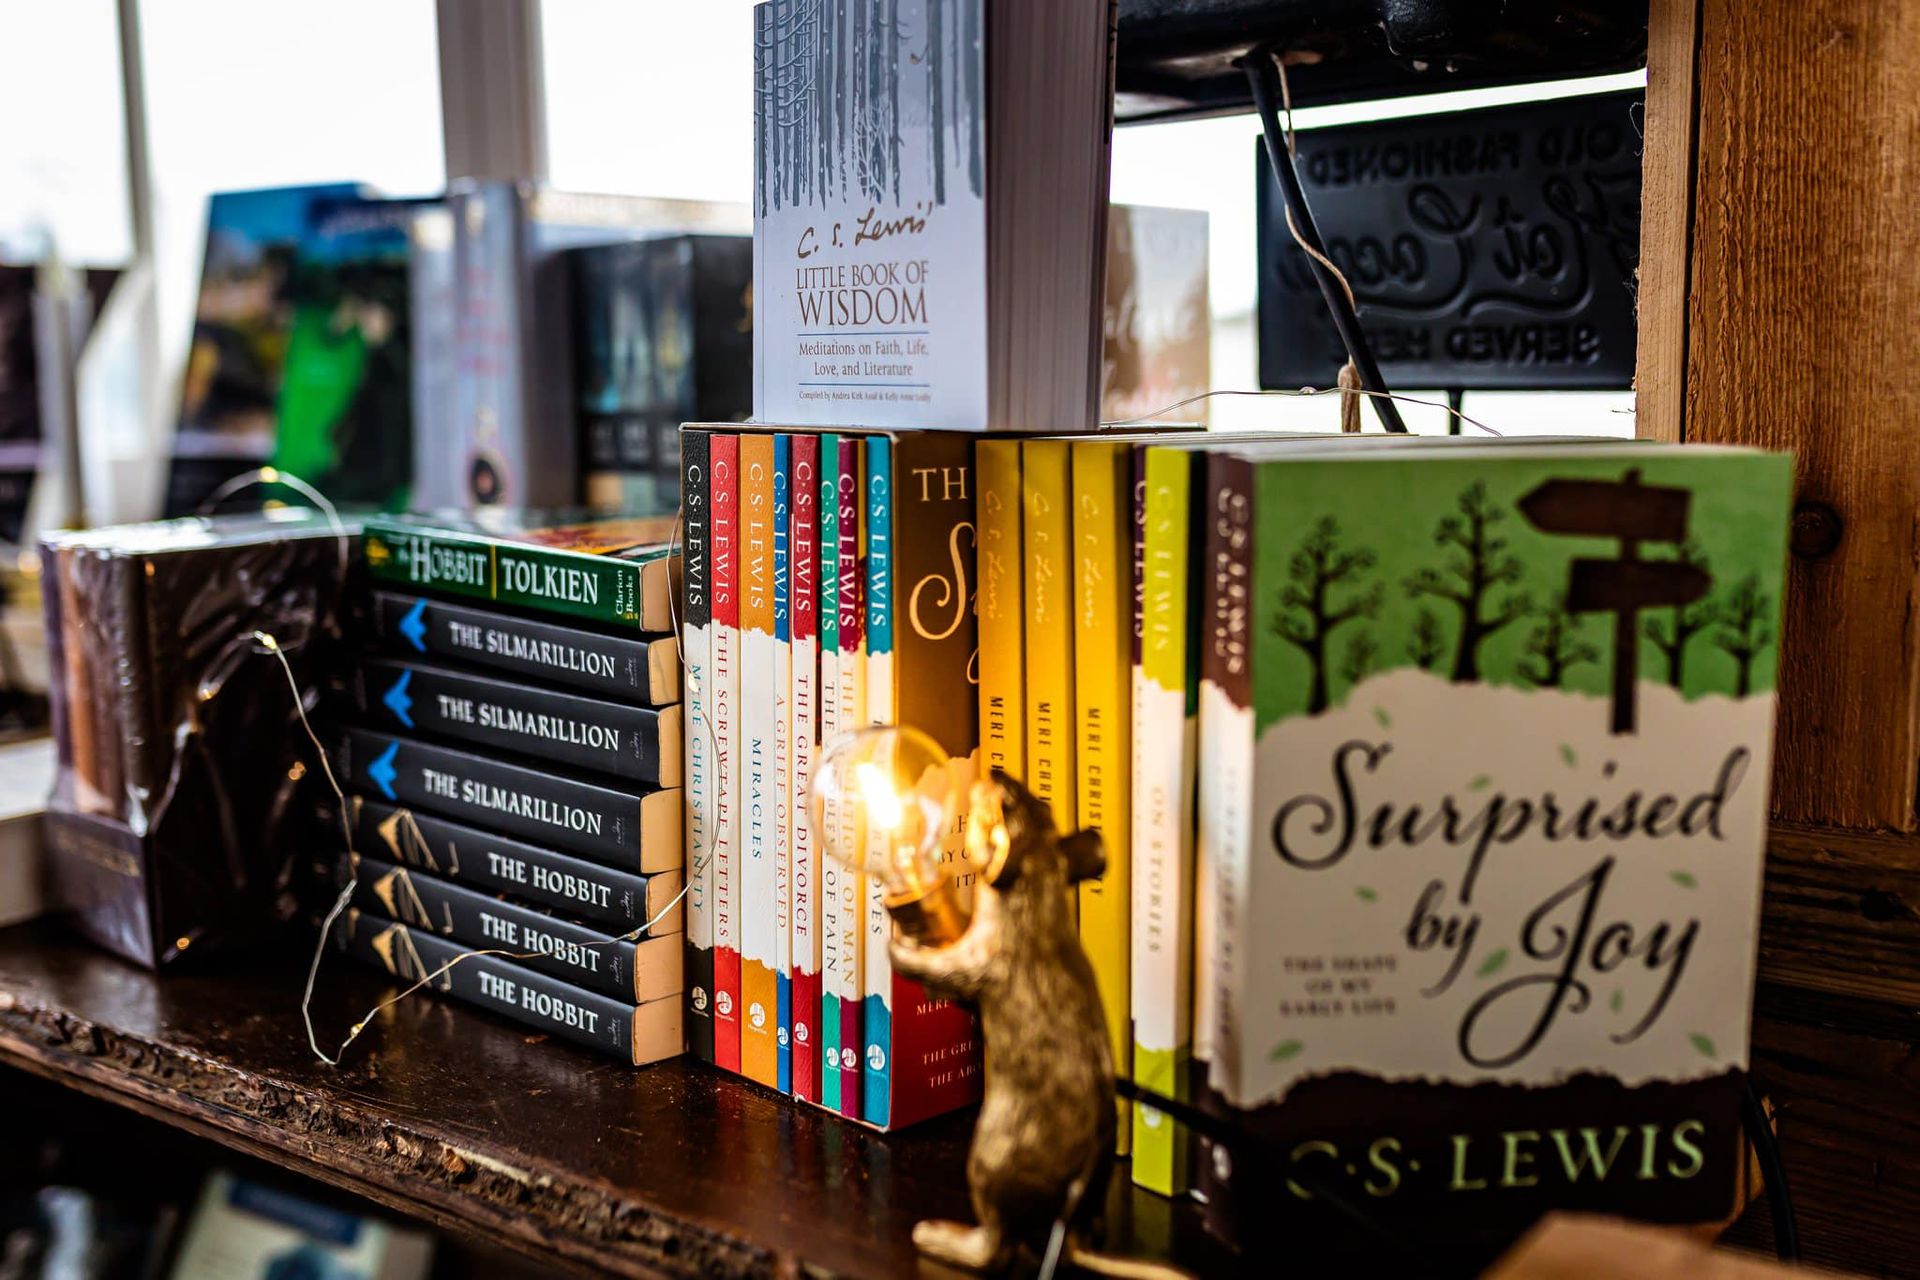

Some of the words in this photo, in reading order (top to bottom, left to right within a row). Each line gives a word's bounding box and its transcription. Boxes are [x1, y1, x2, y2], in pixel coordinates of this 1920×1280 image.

[797, 265, 846, 290] LITTLE
[852, 262, 901, 287] BOOK
[905, 260, 930, 284] OF
[797, 287, 929, 327] WISDOM
[799, 340, 856, 356] Meditations
[859, 343, 872, 355] on
[875, 340, 904, 356] Faith,
[906, 339, 929, 355] Life,
[814, 361, 839, 377] Love,
[842, 361, 860, 376] and
[864, 361, 913, 376] Literature
[912, 466, 969, 502] TH
[410, 536, 488, 585] HOBBIT
[501, 558, 599, 605] TOLKIEN
[689, 522, 702, 605] LEWIS
[715, 518, 730, 604] LEWIS
[750, 522, 764, 609] LEWIS
[774, 532, 787, 620] LEWIS
[796, 522, 811, 611] LEWIS
[821, 542, 836, 631] LEWIS
[839, 536, 856, 627] LEWIS
[871, 534, 887, 627] LEWIS
[615, 569, 623, 615] Clarion
[625, 574, 634, 614] Books
[449, 620, 483, 650] THE
[486, 628, 616, 679] SILMARILLION
[717, 631, 728, 679] THE
[776, 695, 785, 706] A
[797, 674, 808, 725] THE
[824, 681, 835, 731] THE
[842, 668, 854, 718] THE
[990, 696, 1004, 742] MERE
[437, 694, 475, 724] THE
[478, 702, 620, 752] SILMARILLION
[1037, 702, 1052, 746] MERE
[1086, 708, 1102, 752] MERE
[717, 689, 729, 828] SCREWTAPE
[775, 719, 786, 793] GRIEF
[796, 735, 808, 813] GREAT
[422, 768, 459, 800] THE
[462, 779, 602, 836] SILMARILLION
[691, 737, 703, 914] CHRISTIANITY
[751, 738, 762, 861] MIRACLES
[1271, 740, 1750, 904] Surprised
[488, 852, 528, 884] THE
[532, 865, 611, 908] HOBBIT
[717, 839, 729, 938] LETTERS
[776, 803, 788, 930] OBSERVED
[796, 826, 808, 938] DIVORCE
[825, 870, 836, 901] OF
[842, 885, 855, 915] OF
[479, 912, 519, 945] THE
[523, 926, 600, 972] HOBBIT
[825, 913, 838, 973] PAIN
[842, 929, 856, 986] MAN
[1406, 879, 1482, 998] by
[1458, 854, 1700, 1070] Joy
[477, 970, 517, 1005] THE
[521, 986, 599, 1034] HOBBIT
[916, 997, 950, 1016] MERE
[922, 1048, 947, 1066] THE
[928, 1071, 954, 1089] THE
[1450, 1119, 1706, 1193] LEWIS
